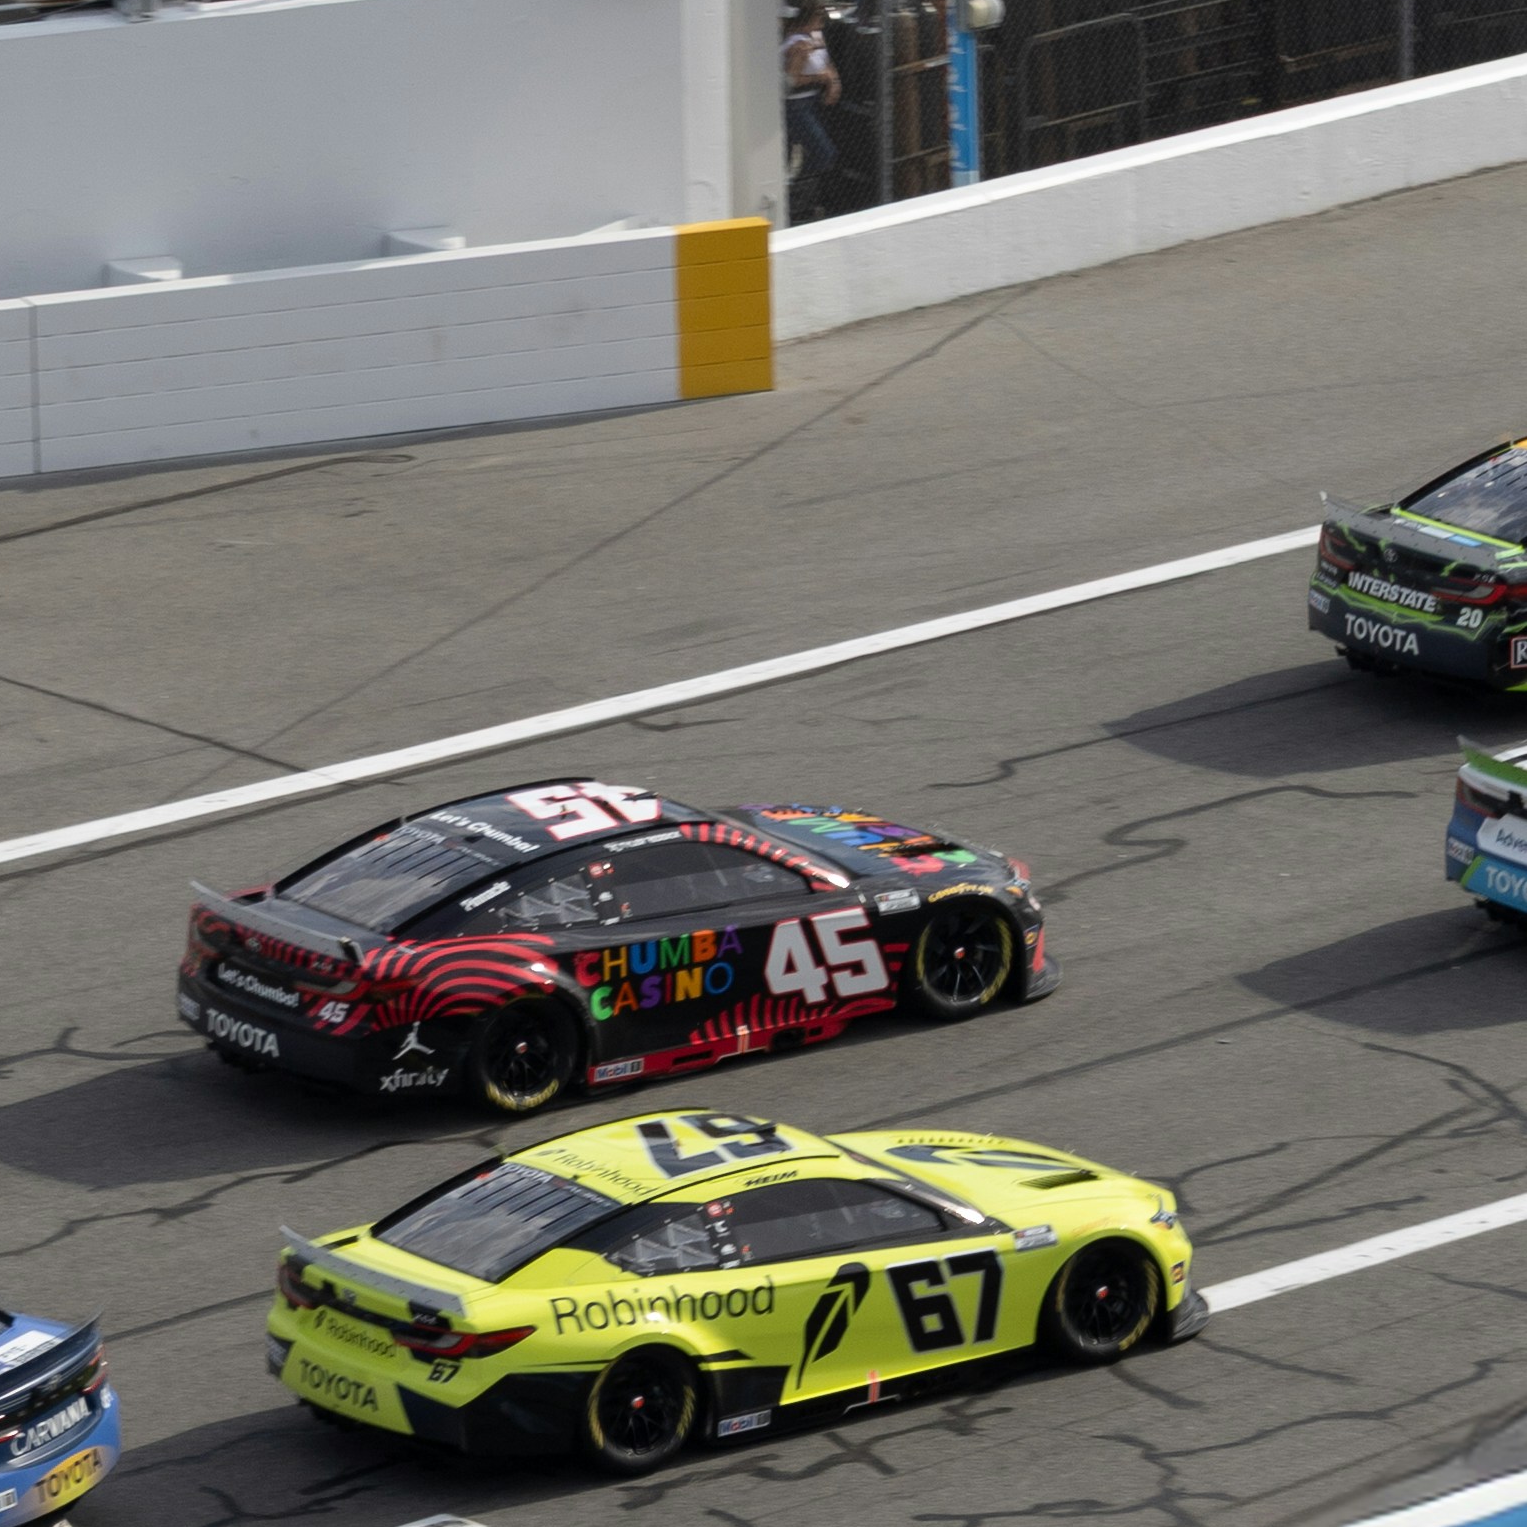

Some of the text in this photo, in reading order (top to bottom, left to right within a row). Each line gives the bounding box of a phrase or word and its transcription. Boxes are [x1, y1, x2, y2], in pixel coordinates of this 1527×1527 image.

[1348, 571, 1439, 613] INTERSTATE
[1456, 606, 1483, 629] 20
[1345, 613, 1420, 656] TOYOTA
[1485, 864, 1527, 897] TOY
[575, 926, 744, 987] CHUMBA
[765, 906, 891, 1004] 45
[319, 1001, 350, 1024] 45
[590, 962, 735, 1020] CASINO
[205, 1007, 280, 1058] TOYOTA
[379, 1067, 450, 1092] xfinity
[553, 1152, 659, 1197] Robinhood
[548, 1274, 775, 1336] Robinhood
[885, 1246, 1004, 1354] 67
[298, 1359, 379, 1412] TOYOTA
[427, 1358, 462, 1384] 67
[9, 1395, 93, 1457] CARVANA
[34, 1447, 103, 1504] TOYOTA
